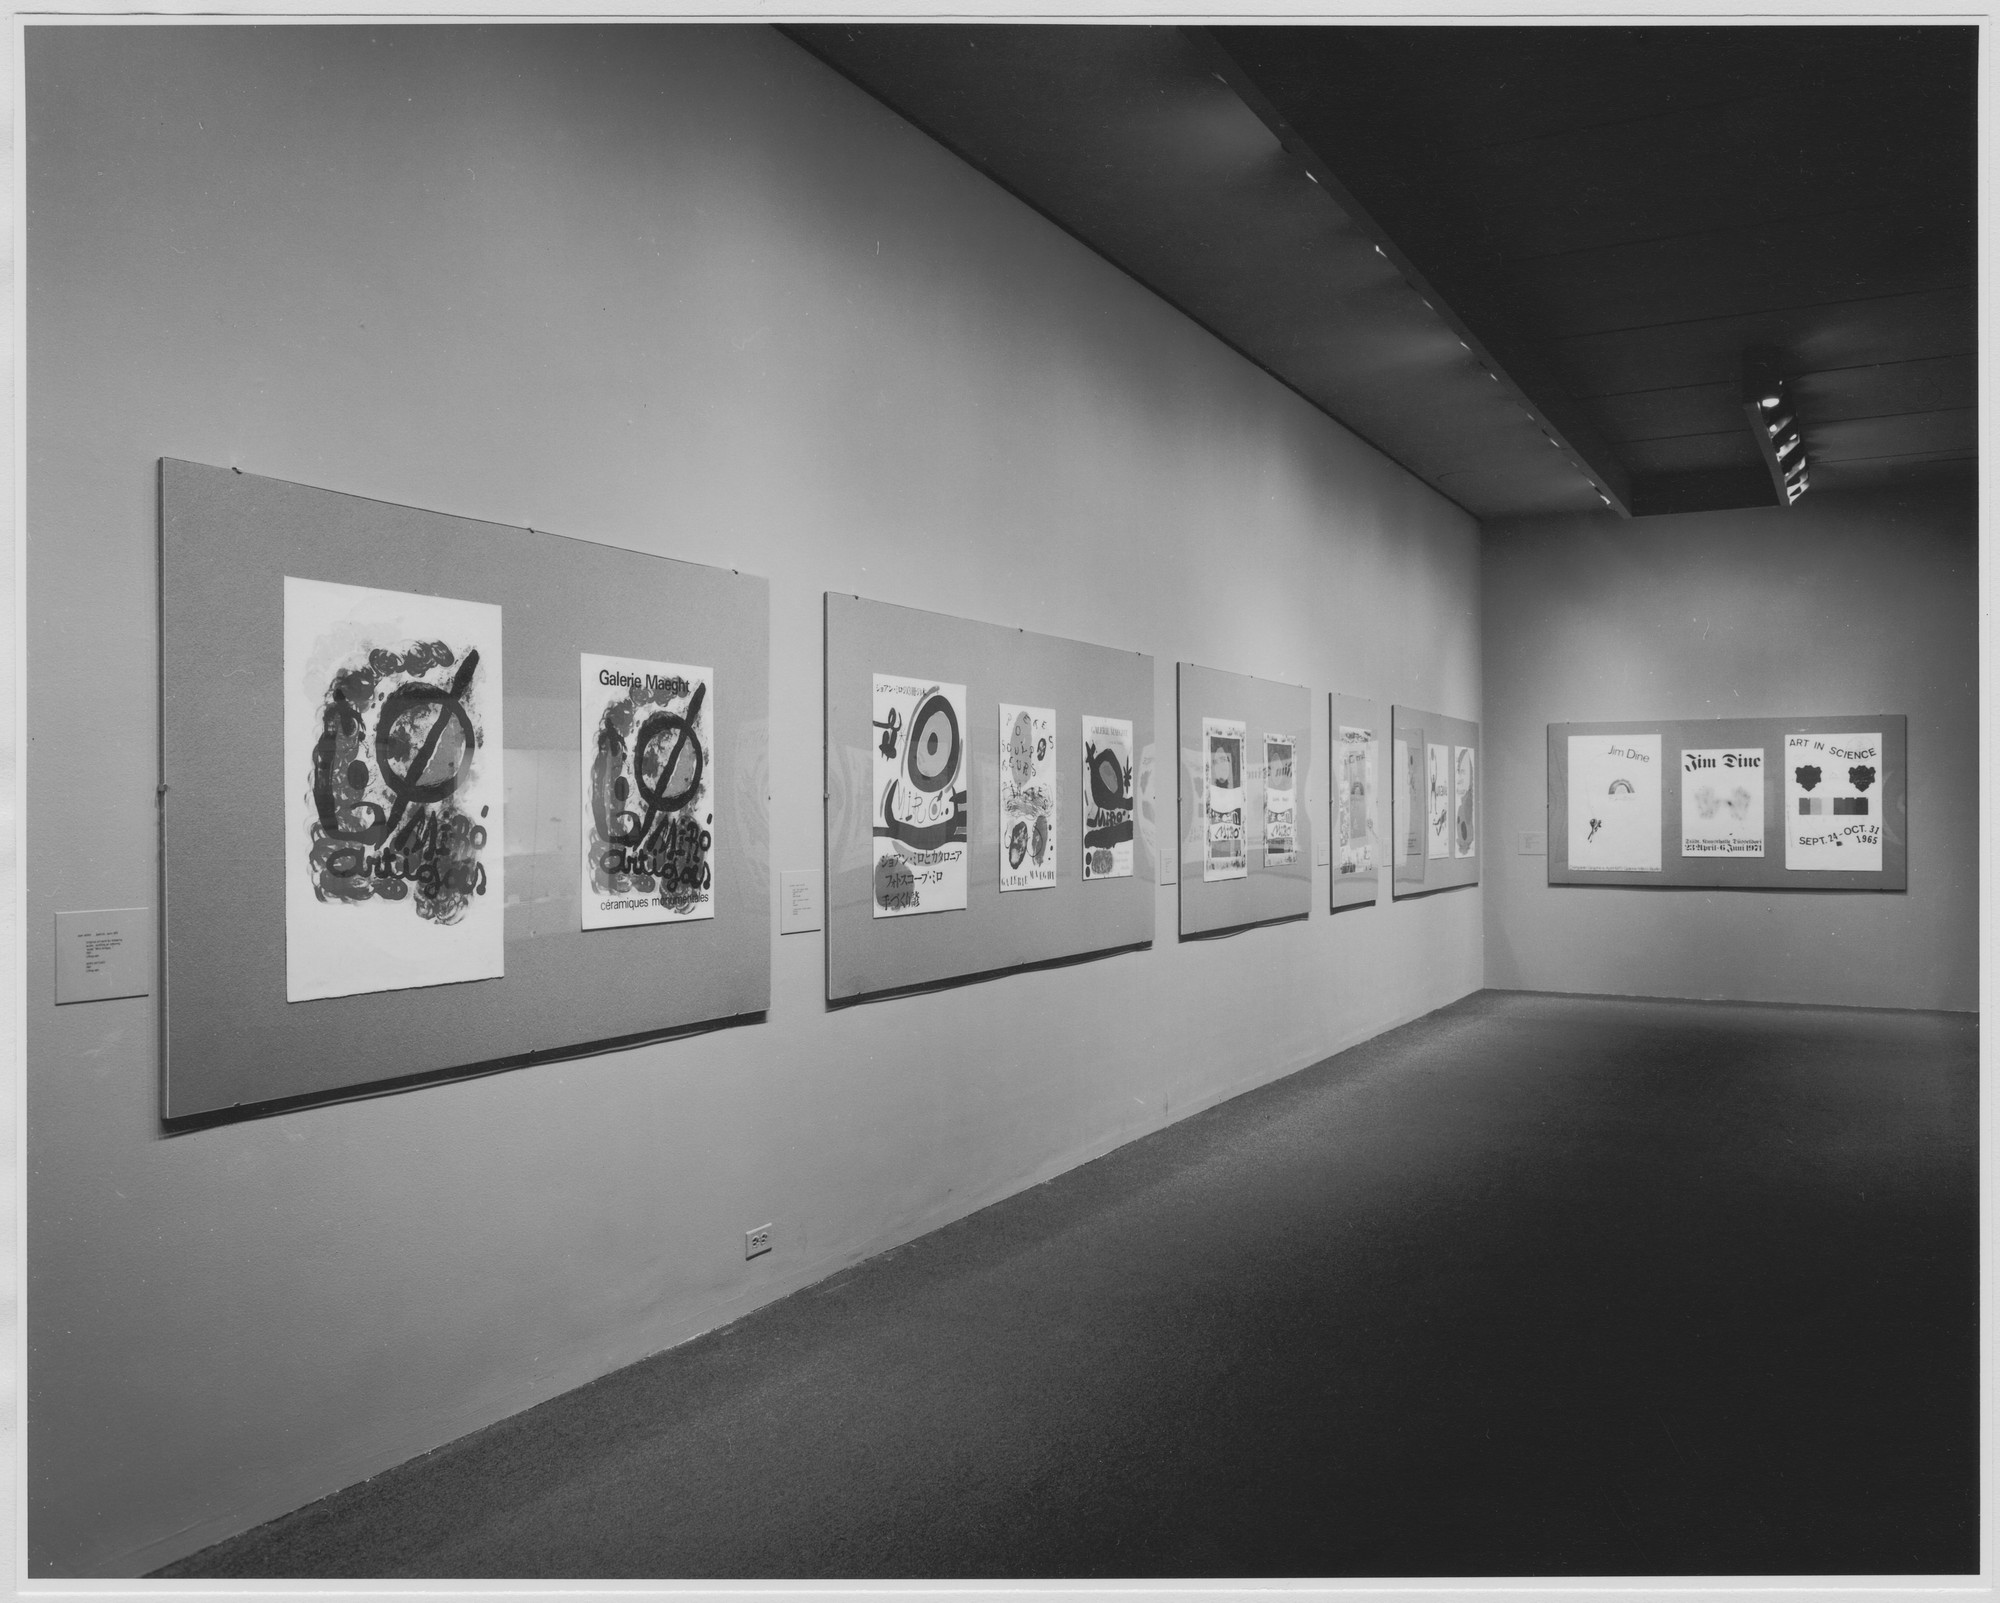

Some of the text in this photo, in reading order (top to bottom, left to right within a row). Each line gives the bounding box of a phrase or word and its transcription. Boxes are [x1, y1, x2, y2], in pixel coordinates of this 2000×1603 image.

[599, 669, 690, 695] Galerie Maeght
[1608, 745, 1650, 763] Jim Dine
[1789, 739, 1877, 760] ART IN SCIENCE
[1685, 753, 1761, 773] Jim Dine
[1799, 835, 1828, 847] SEPT.
[1828, 832, 1838, 843] 24
[1869, 825, 1880, 835] 31
[1856, 834, 1878, 845] 1965
[600, 893, 709, 911] céramiques monumentales
